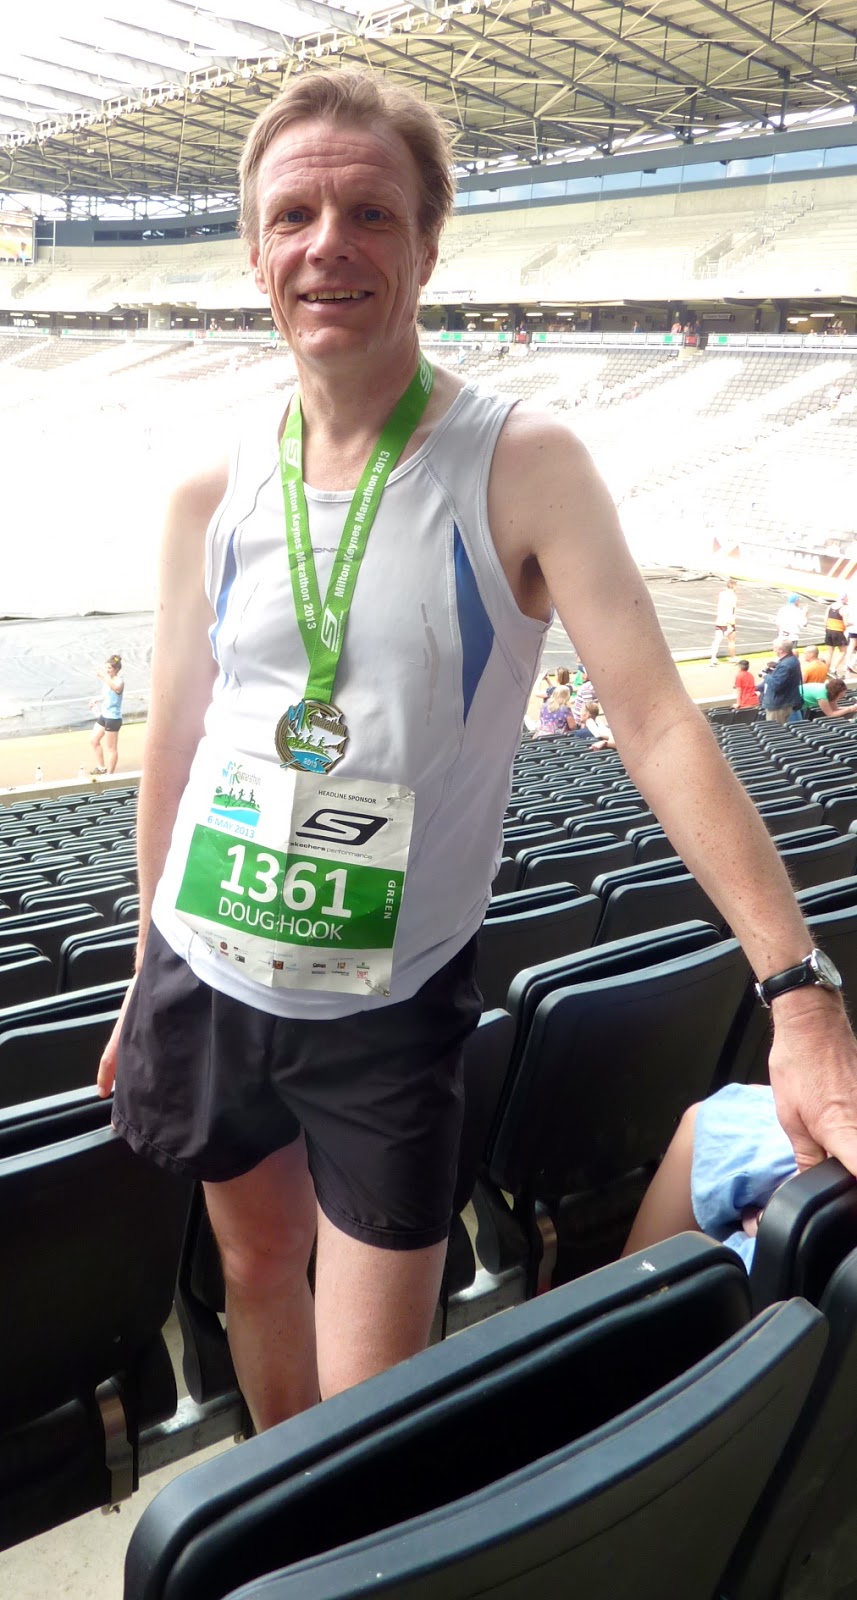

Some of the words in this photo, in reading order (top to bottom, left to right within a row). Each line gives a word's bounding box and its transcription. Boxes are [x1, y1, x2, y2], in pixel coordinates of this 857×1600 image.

[287, 481, 298, 511] Milton
[291, 513, 303, 550] Keynes
[334, 564, 351, 598] Milton
[343, 525, 362, 562] Keynes
[355, 475, 379, 522] Marathon
[372, 451, 391, 473] 2013
[296, 551, 310, 601] Marathon
[303, 603, 317, 630] 2013
[318, 789, 348, 800] HEADLINE
[347, 794, 377, 804] SPONSOR
[207, 815, 214, 824] 6
[214, 817, 234, 831] MAY
[234, 824, 256, 839] 2013
[290, 841, 326, 852] skechers
[326, 847, 373, 860] performance
[220, 844, 352, 918] 1361
[383, 880, 396, 919] GREEN
[218, 896, 275, 930] DOUG
[279, 914, 344, 941] HOOK
